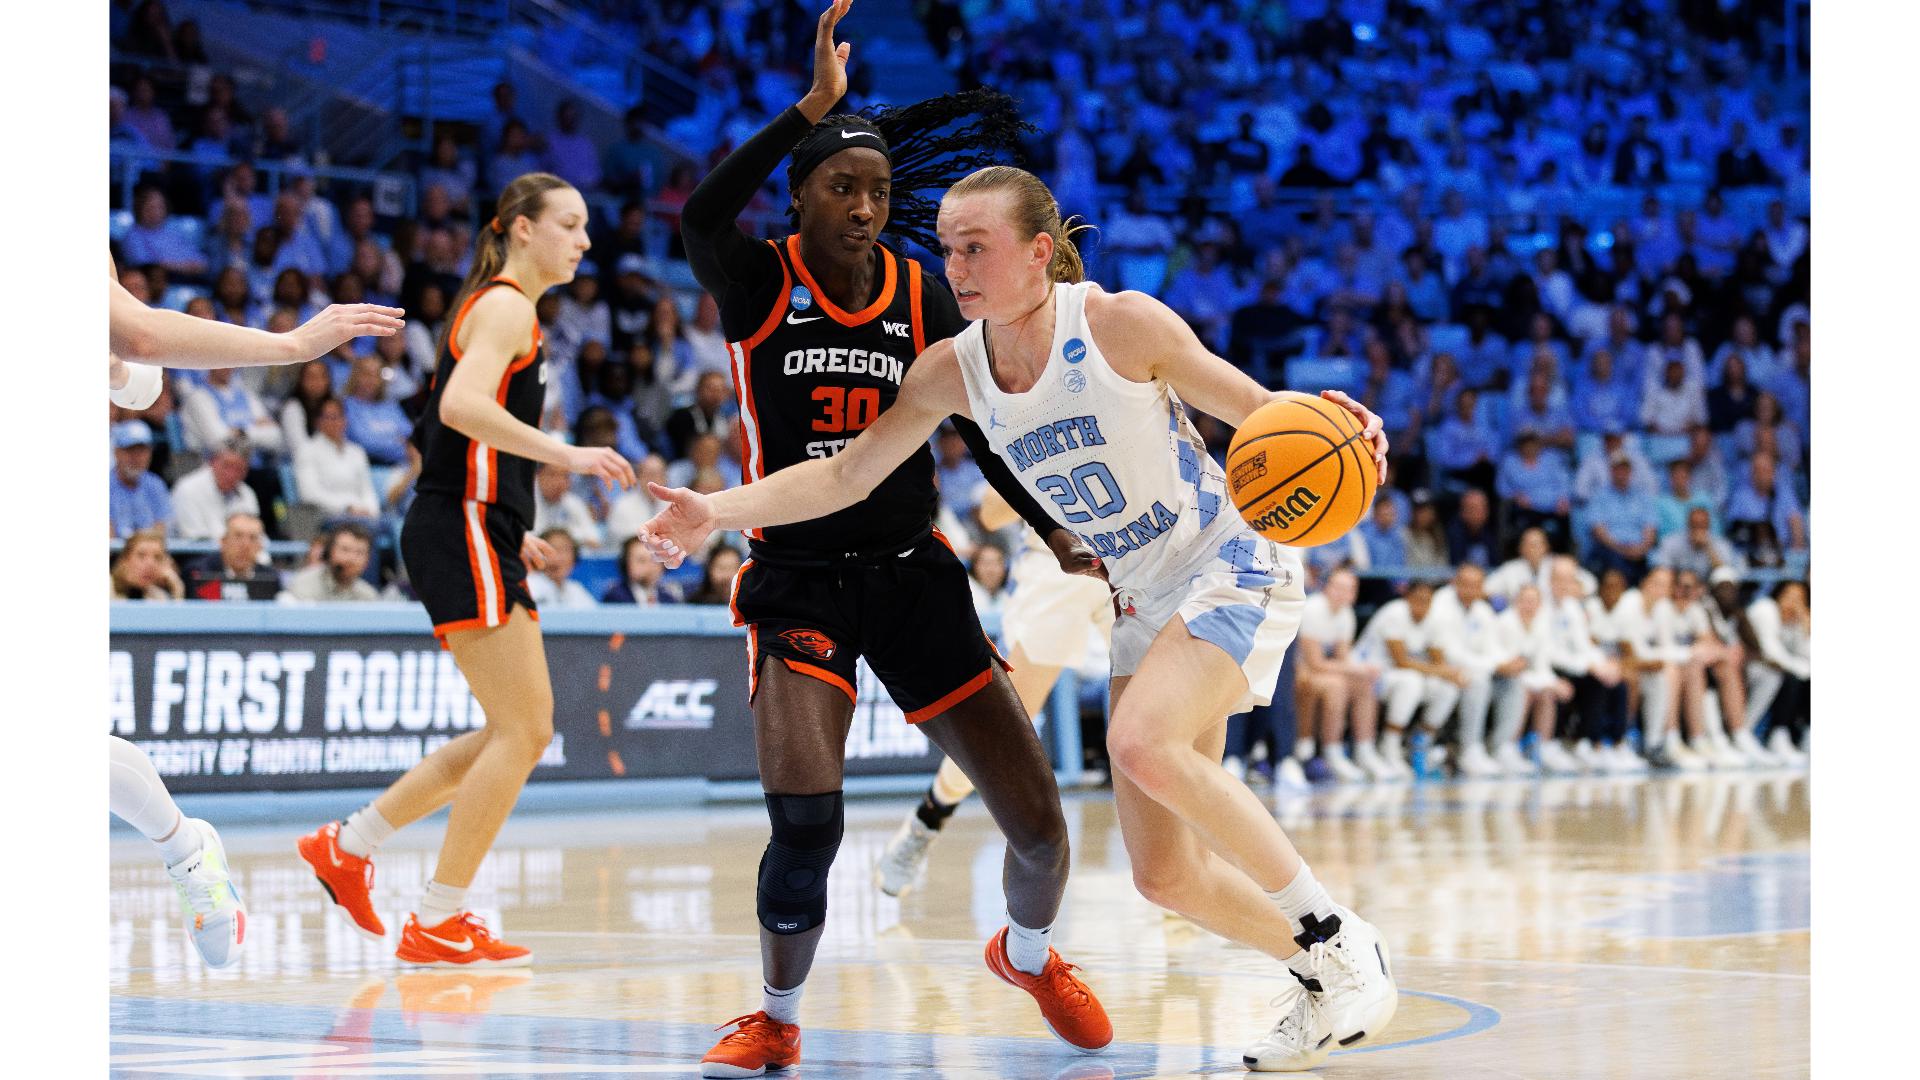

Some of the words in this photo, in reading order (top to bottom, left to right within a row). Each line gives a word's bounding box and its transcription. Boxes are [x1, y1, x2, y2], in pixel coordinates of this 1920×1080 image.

[882, 320, 909, 338] WCC
[1067, 345, 1086, 360] NCAA
[783, 348, 904, 386] OREGON
[811, 386, 880, 432] 30
[1006, 415, 1106, 472] NORTH
[1035, 461, 1127, 523] 20
[151, 651, 316, 733] FIRST
[625, 679, 718, 728] ACC
